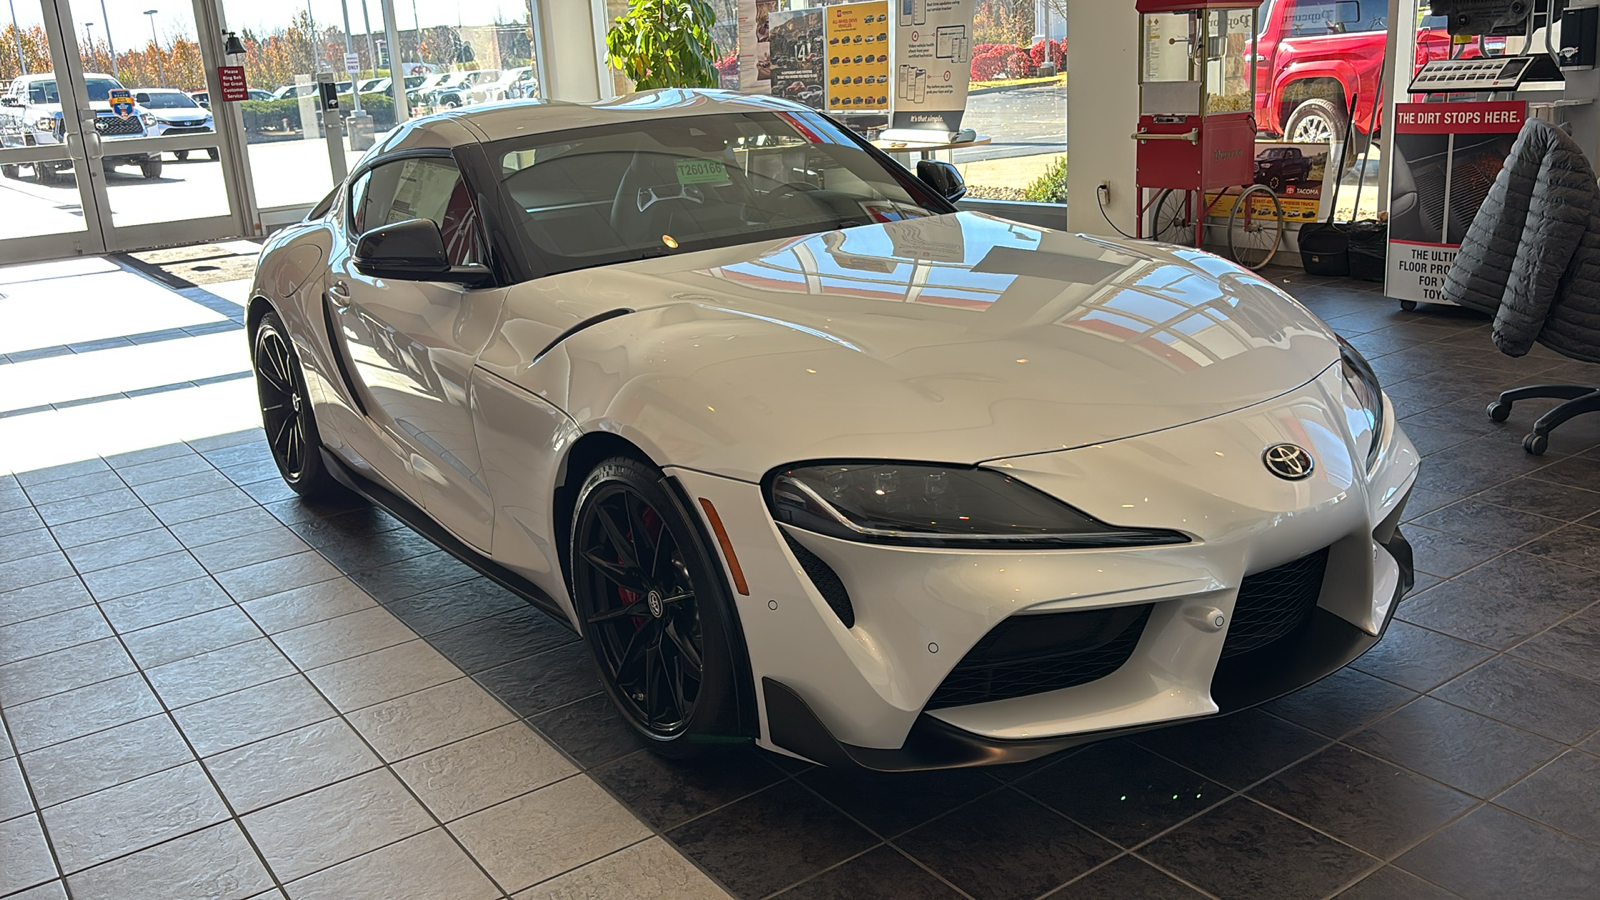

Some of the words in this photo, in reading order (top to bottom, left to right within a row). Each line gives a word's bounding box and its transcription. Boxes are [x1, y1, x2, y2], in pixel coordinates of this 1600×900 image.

[927, 114, 944, 123] simple.
[1398, 112, 1415, 124] THE
[1417, 112, 1441, 124] DIRT
[1444, 111, 1480, 124] STOPS
[1484, 111, 1520, 123] HERE.
[1214, 149, 1244, 161] Popcorn
[678, 162, 721, 176] T260166
[1412, 249, 1428, 260] THE
[1399, 261, 1427, 273] FLOOR
[1430, 264, 1451, 275] PRO
[1419, 276, 1437, 287] FOR
